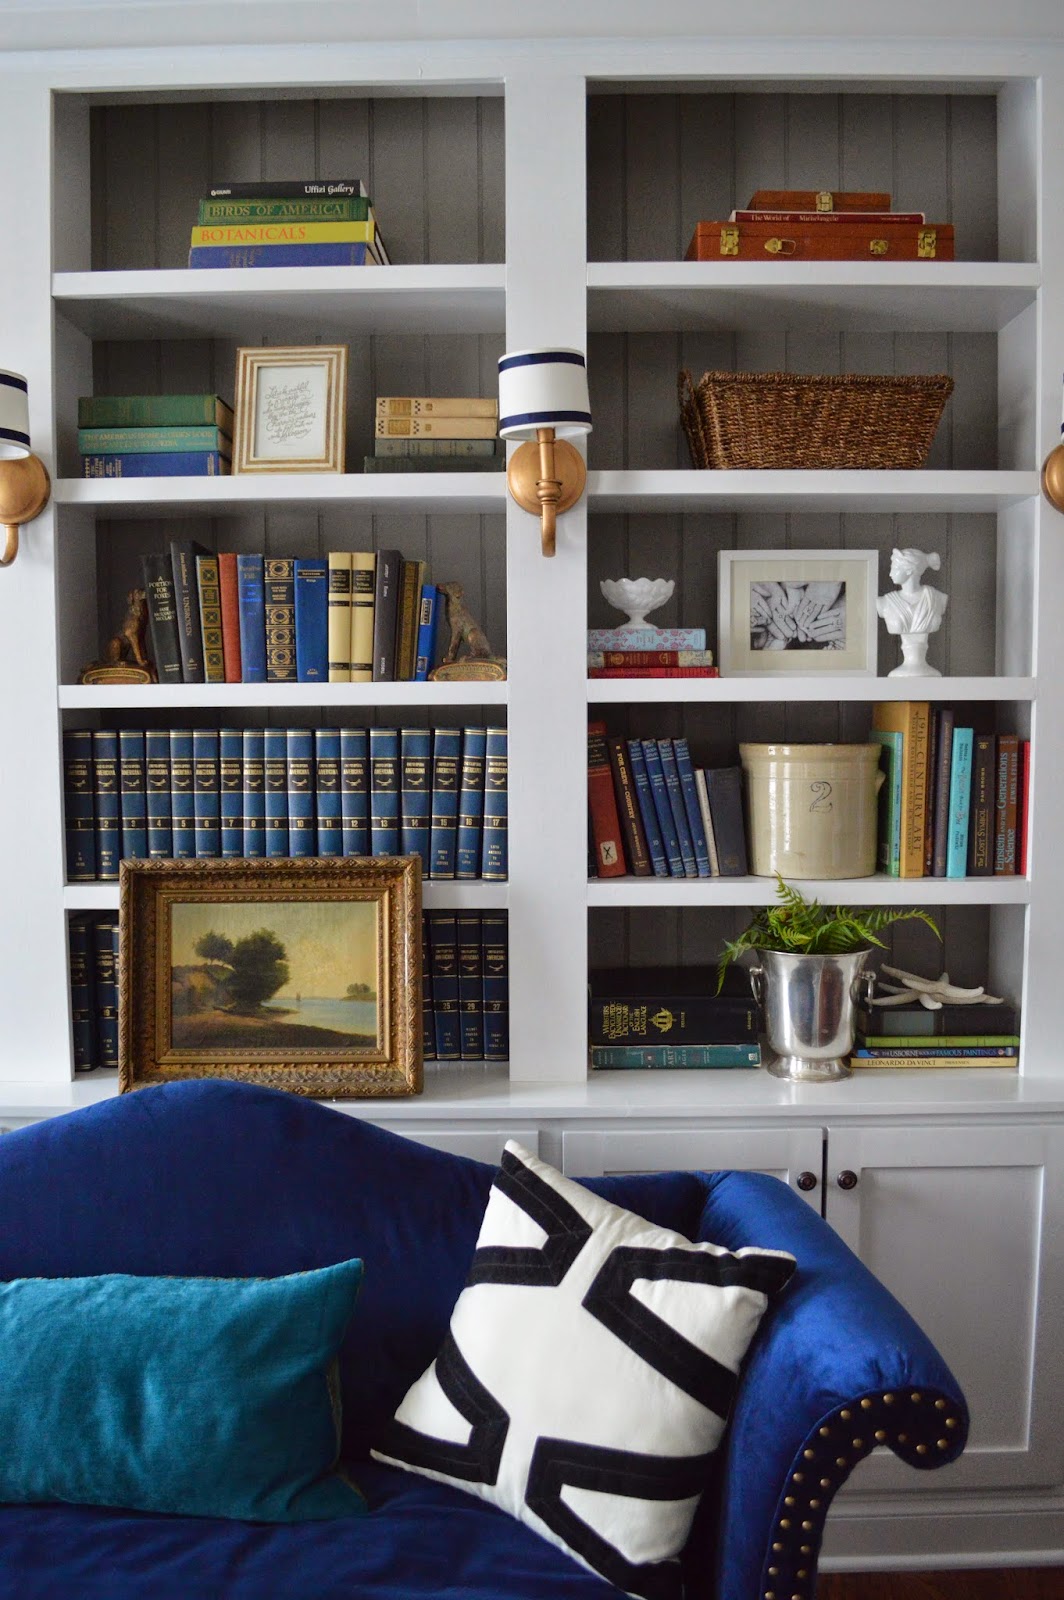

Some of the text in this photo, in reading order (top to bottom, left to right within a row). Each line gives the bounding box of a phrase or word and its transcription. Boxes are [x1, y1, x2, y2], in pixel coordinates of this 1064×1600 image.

[304, 183, 355, 195] Uffizi Gallery
[211, 202, 342, 217] BIRDS OF AMERICA
[201, 226, 306, 242] BOTANICALS
[183, 597, 192, 636] UNBROKEN
[996, 752, 1008, 809] Generations
[619, 767, 629, 785] CREW
[624, 790, 635, 820] COUNTRY
[809, 781, 833, 813] 2
[131, 820, 135, 828] 3
[156, 820, 161, 828] 4
[181, 820, 186, 828] 5
[204, 820, 209, 828] 6
[229, 819, 234, 827] 7
[251, 820, 256, 828] 8
[274, 820, 279, 828] 9
[297, 820, 304, 828] 10
[326, 820, 332, 828] 11
[351, 820, 358, 828] 12
[381, 820, 388, 828] 13
[411, 819, 418, 827] 14
[440, 819, 447, 827] 15
[466, 818, 472, 826] 16
[493, 819, 499, 827] 17
[976, 809, 986, 837] SYMBOL
[913, 826, 923, 852] ART
[976, 839, 985, 857] LOST
[1005, 829, 1015, 864] Science
[995, 834, 1005, 871] Einstein
[632, 1008, 640, 1032] ENGLISH
[639, 1005, 647, 1035] LANGUAGE
